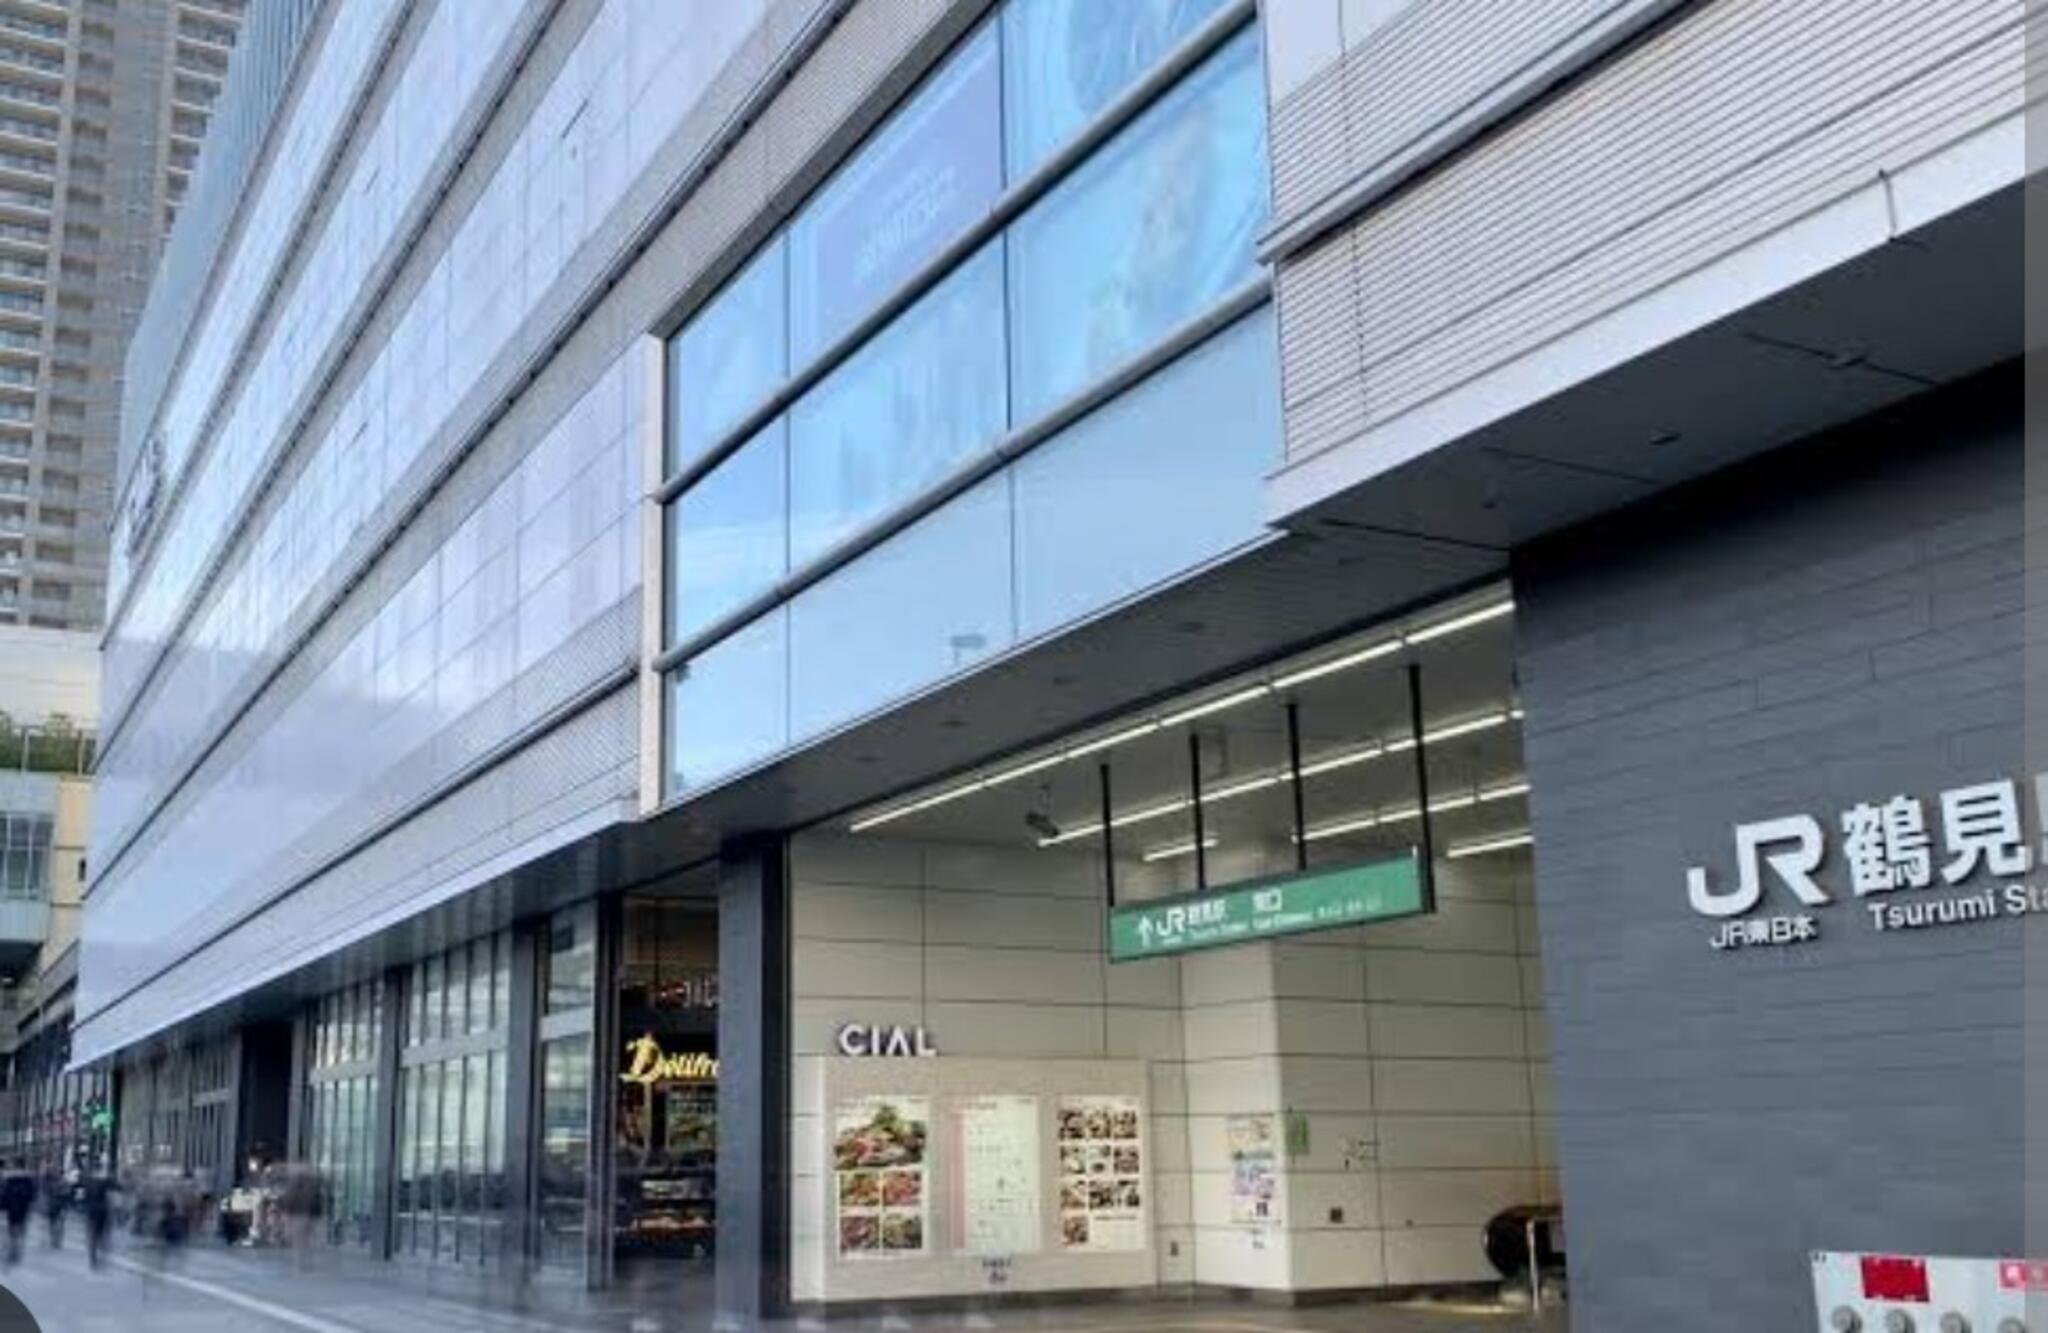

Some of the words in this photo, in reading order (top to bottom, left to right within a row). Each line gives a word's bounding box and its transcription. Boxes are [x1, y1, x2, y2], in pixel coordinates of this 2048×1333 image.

[1868, 889, 1996, 930] Tsurumi
[1709, 915, 1819, 949] JR東日本
[839, 1023, 937, 1057] CIAL
